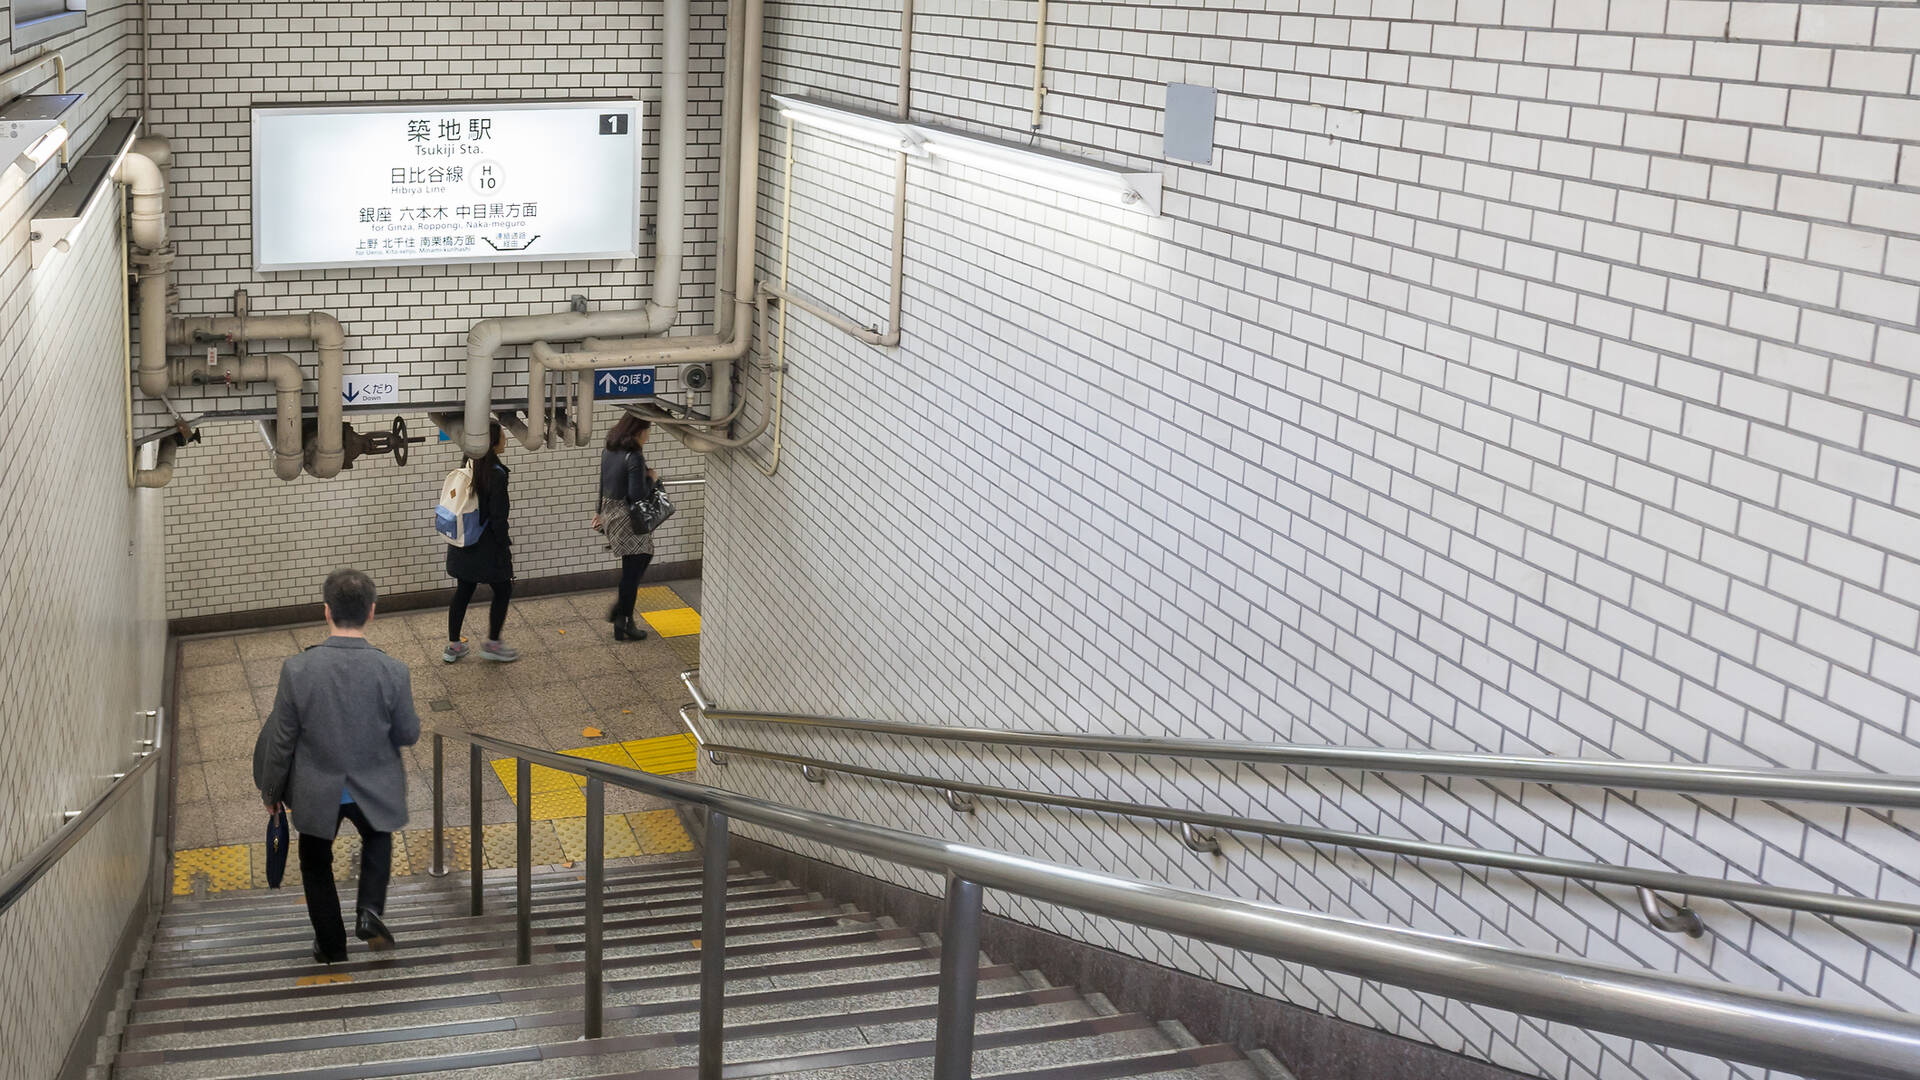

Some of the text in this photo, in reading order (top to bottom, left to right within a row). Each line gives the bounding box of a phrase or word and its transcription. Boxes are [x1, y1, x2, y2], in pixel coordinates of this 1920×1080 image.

[407, 118, 491, 142] 築地駅
[607, 115, 618, 133] 1
[415, 143, 484, 158] Tsukiji Sta.
[391, 165, 464, 184] 日比谷線
[482, 165, 492, 175] H
[480, 177, 496, 189] 10
[391, 186, 446, 195] Hibiya Line
[359, 202, 538, 223] 銀座 六本木 中目黒方面
[466, 220, 526, 230] Naka-meguro
[356, 234, 475, 249] 上野 北千住 南栗橋方面
[618, 373, 651, 385] のぼり
[363, 383, 393, 395] くだり
